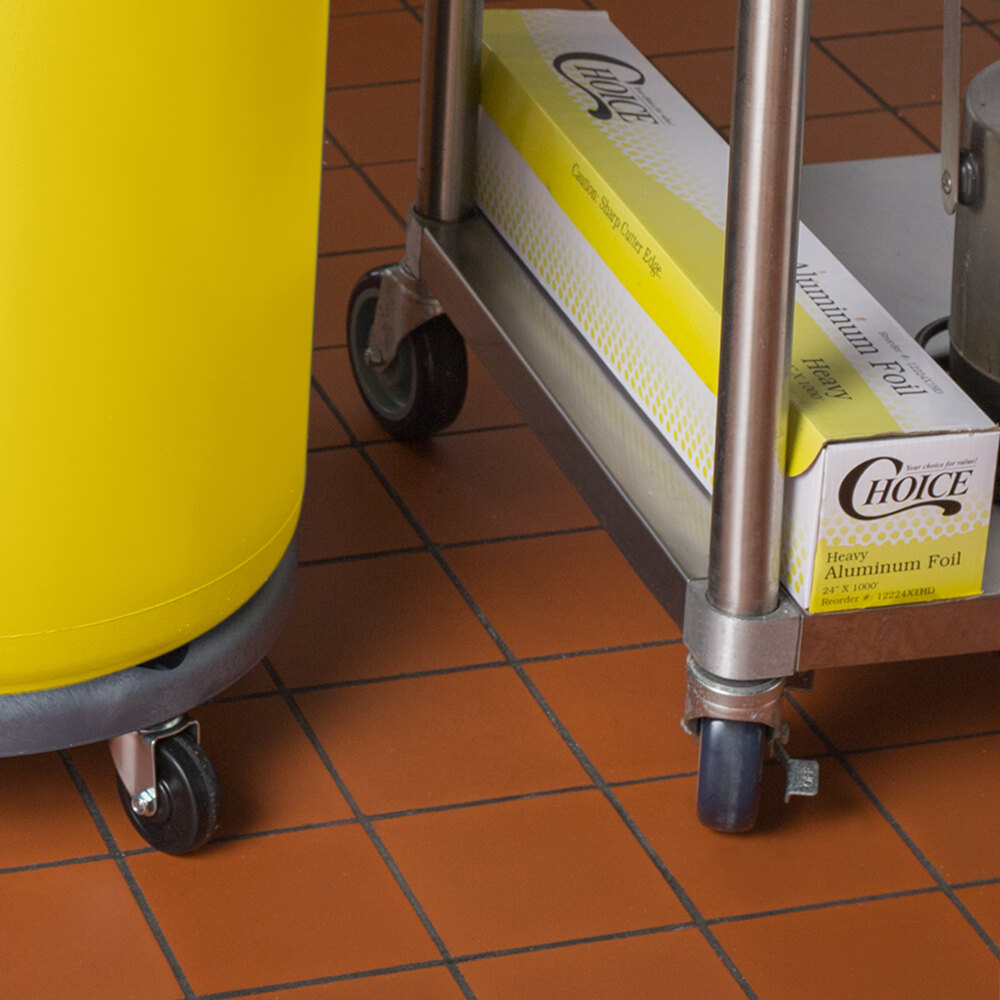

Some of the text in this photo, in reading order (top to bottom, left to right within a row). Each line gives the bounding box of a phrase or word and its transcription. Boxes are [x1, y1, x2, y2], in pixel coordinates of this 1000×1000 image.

[553, 52, 659, 125] CHOICE
[598, 195, 621, 230] Sharp
[620, 221, 644, 254] Cutter
[801, 357, 853, 401] Heavy
[868, 360, 928, 396] Foil
[838, 456, 974, 521] CHOICE
[824, 551, 962, 580] Aluminum Foil
[827, 551, 869, 564] Heavy
[821, 595, 860, 606] Reorder
